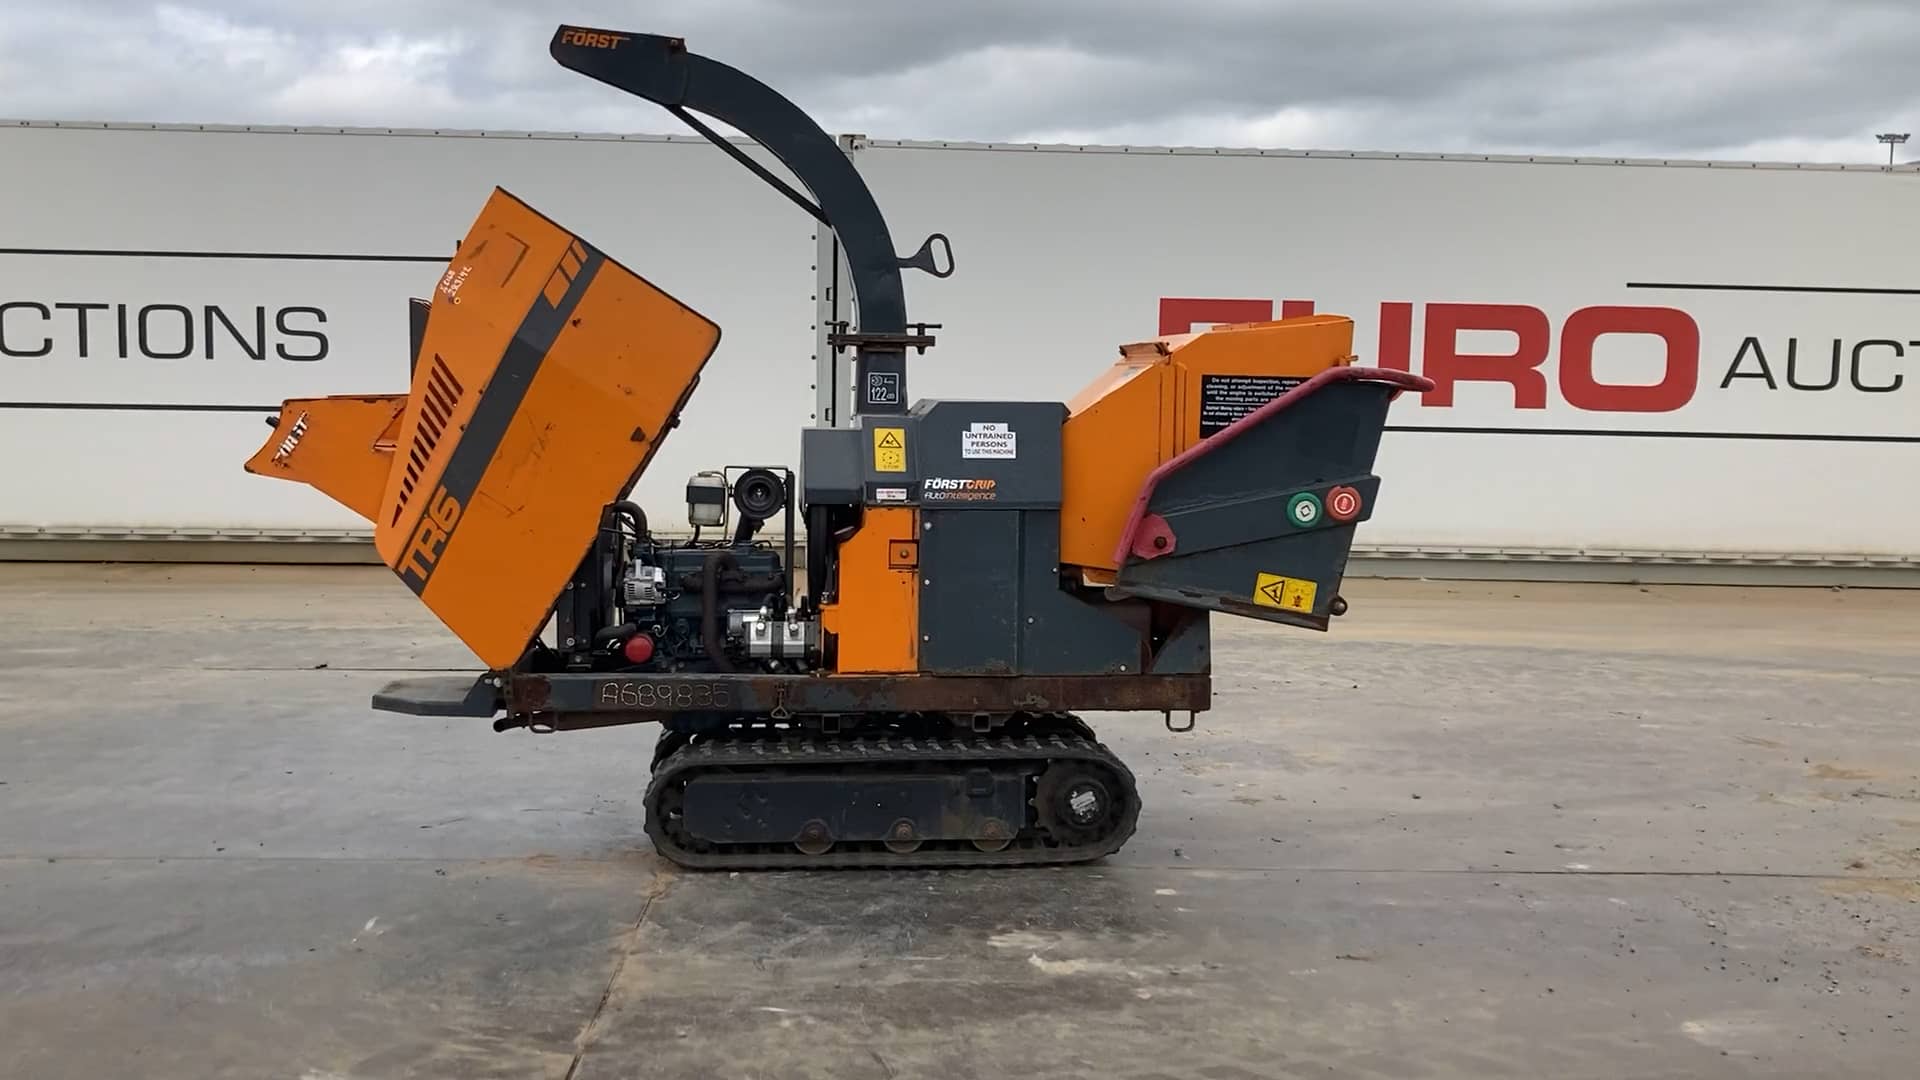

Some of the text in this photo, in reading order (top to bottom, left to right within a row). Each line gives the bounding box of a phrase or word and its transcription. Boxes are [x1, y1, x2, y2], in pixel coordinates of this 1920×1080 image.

[0, 301, 329, 362] CTIONS
[1720, 336, 1920, 392] AUC
[871, 387, 887, 400] 122
[401, 485, 462, 581] TR6
